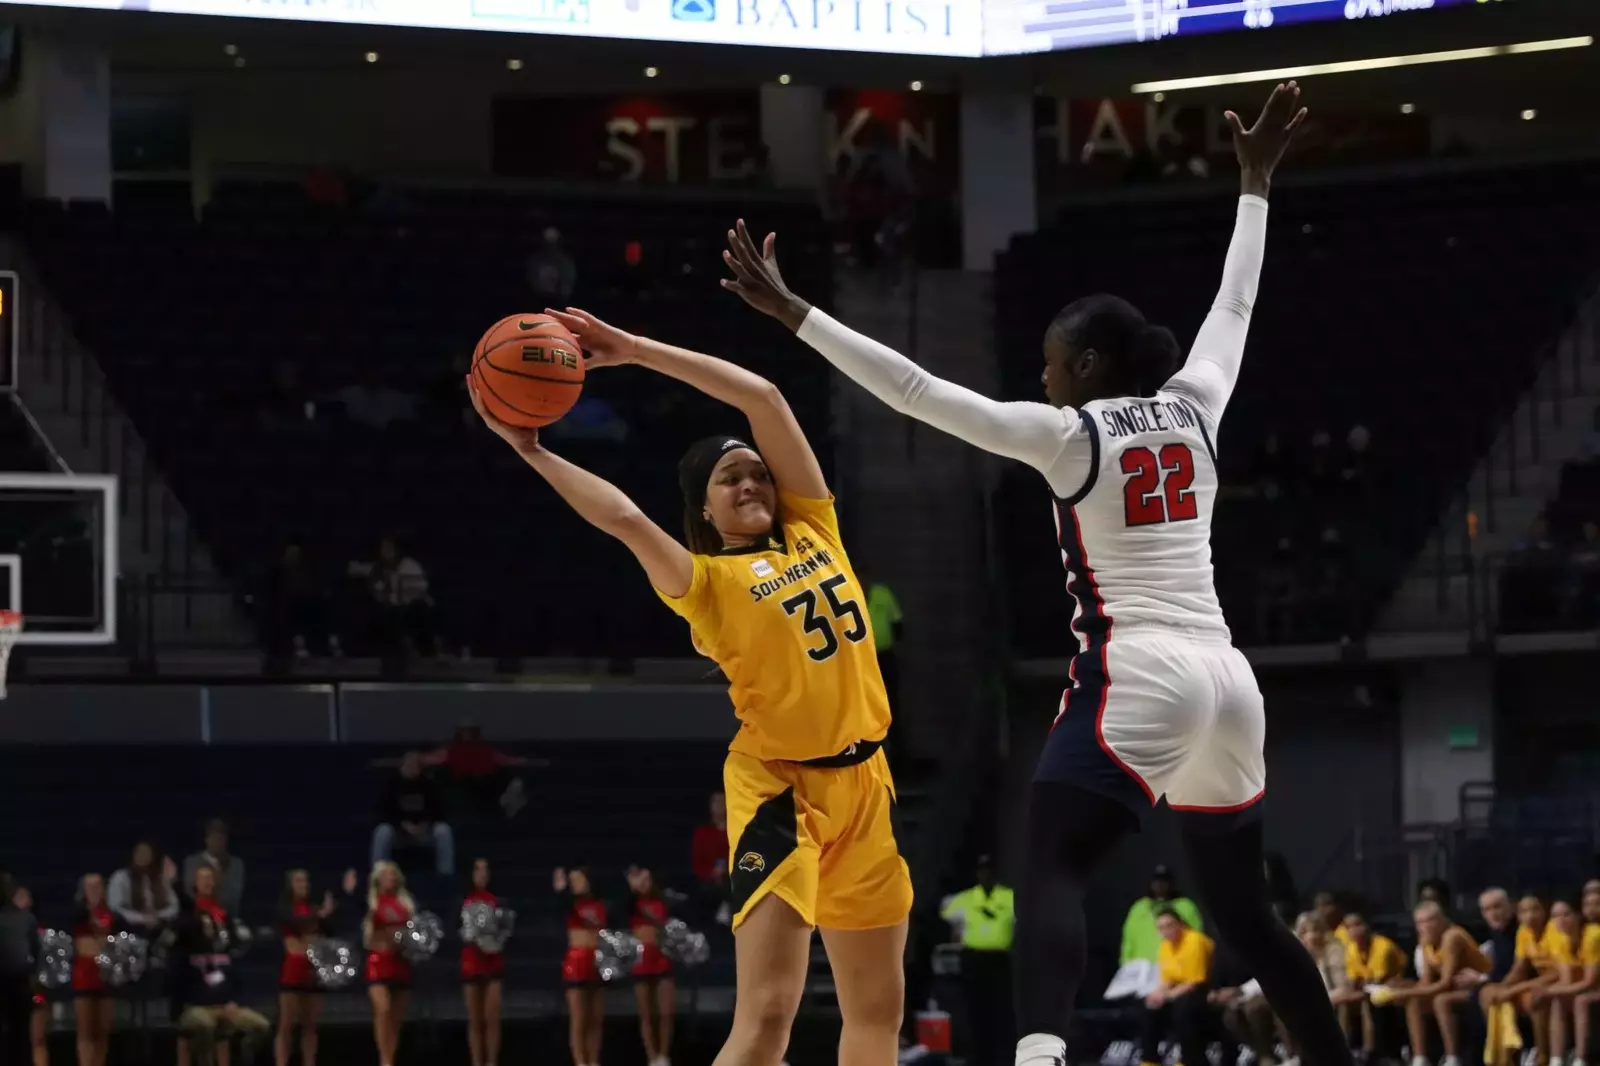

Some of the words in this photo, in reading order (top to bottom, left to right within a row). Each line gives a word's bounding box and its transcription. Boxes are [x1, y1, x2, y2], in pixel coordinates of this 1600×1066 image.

[520, 345, 578, 370] ELITE
[1101, 401, 1195, 437] SINGLETON
[1119, 442, 1198, 527] 22
[750, 556, 820, 602] SOUTHERN
[781, 572, 867, 663] 35
